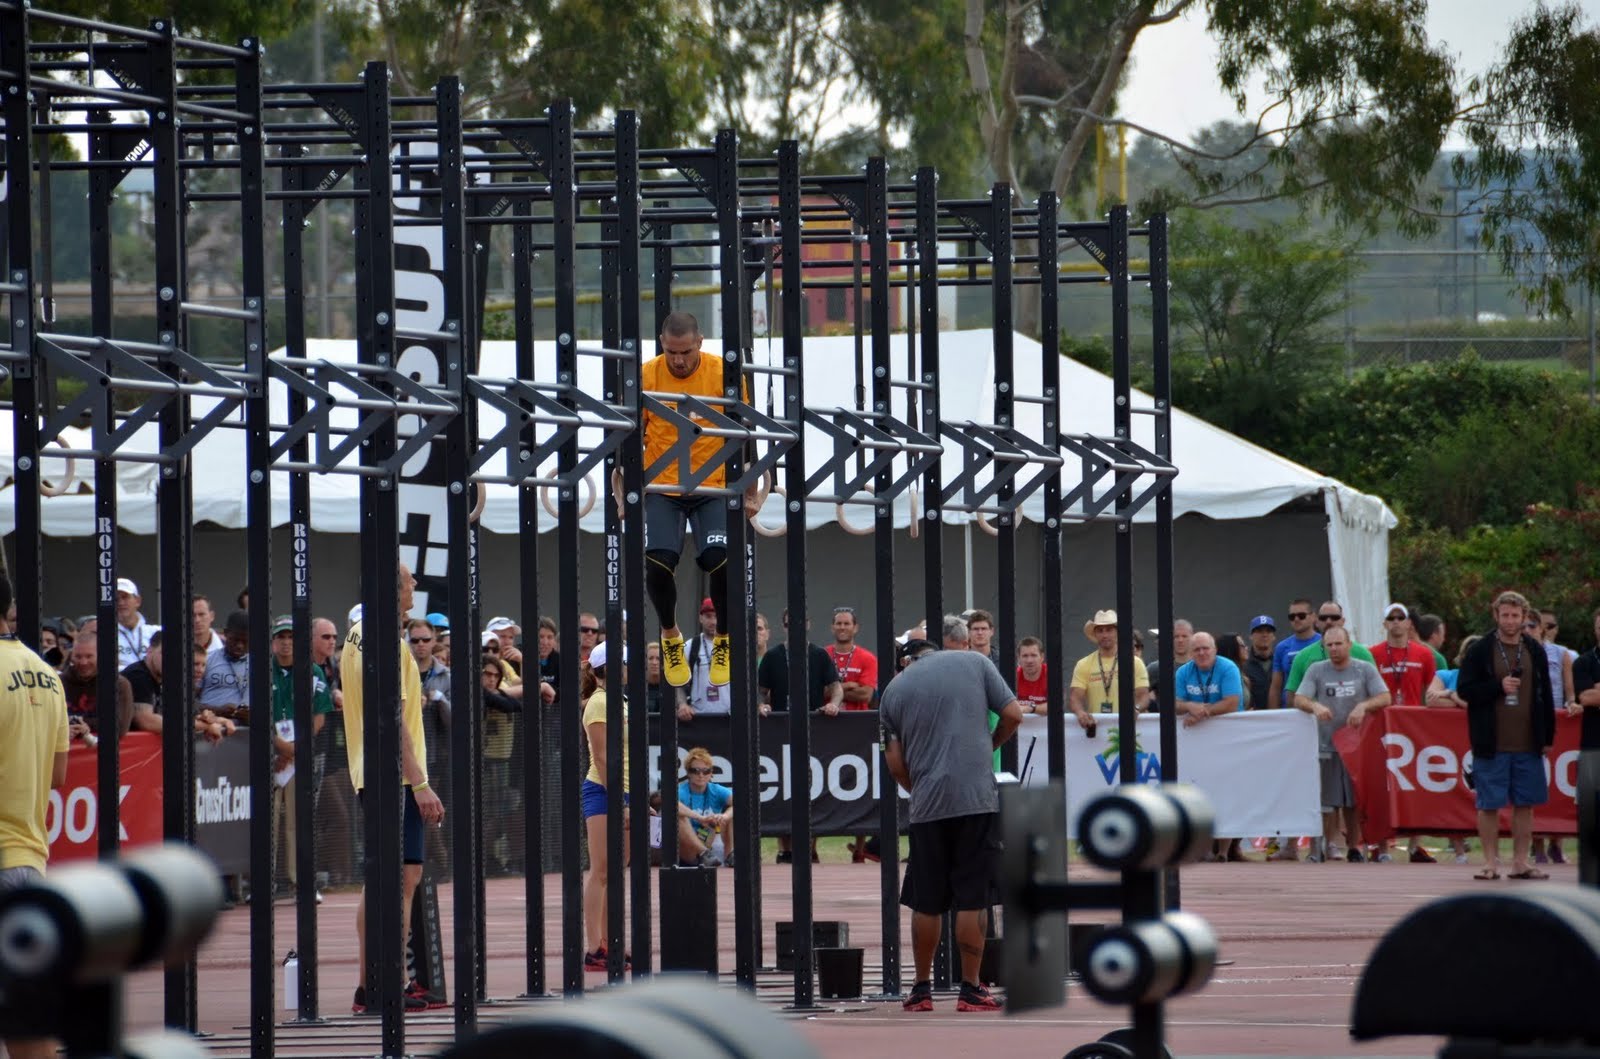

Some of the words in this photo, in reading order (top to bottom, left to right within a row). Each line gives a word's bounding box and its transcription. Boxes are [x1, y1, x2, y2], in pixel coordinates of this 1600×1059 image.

[98, 517, 113, 602] ROGUE
[294, 523, 307, 597] ROGUE
[607, 534, 619, 601] ROGUE
[7, 670, 60, 696] JUDGE
[1186, 684, 1219, 696] Reok
[1094, 751, 1163, 786] VTA
[1380, 732, 1581, 799] Reo
